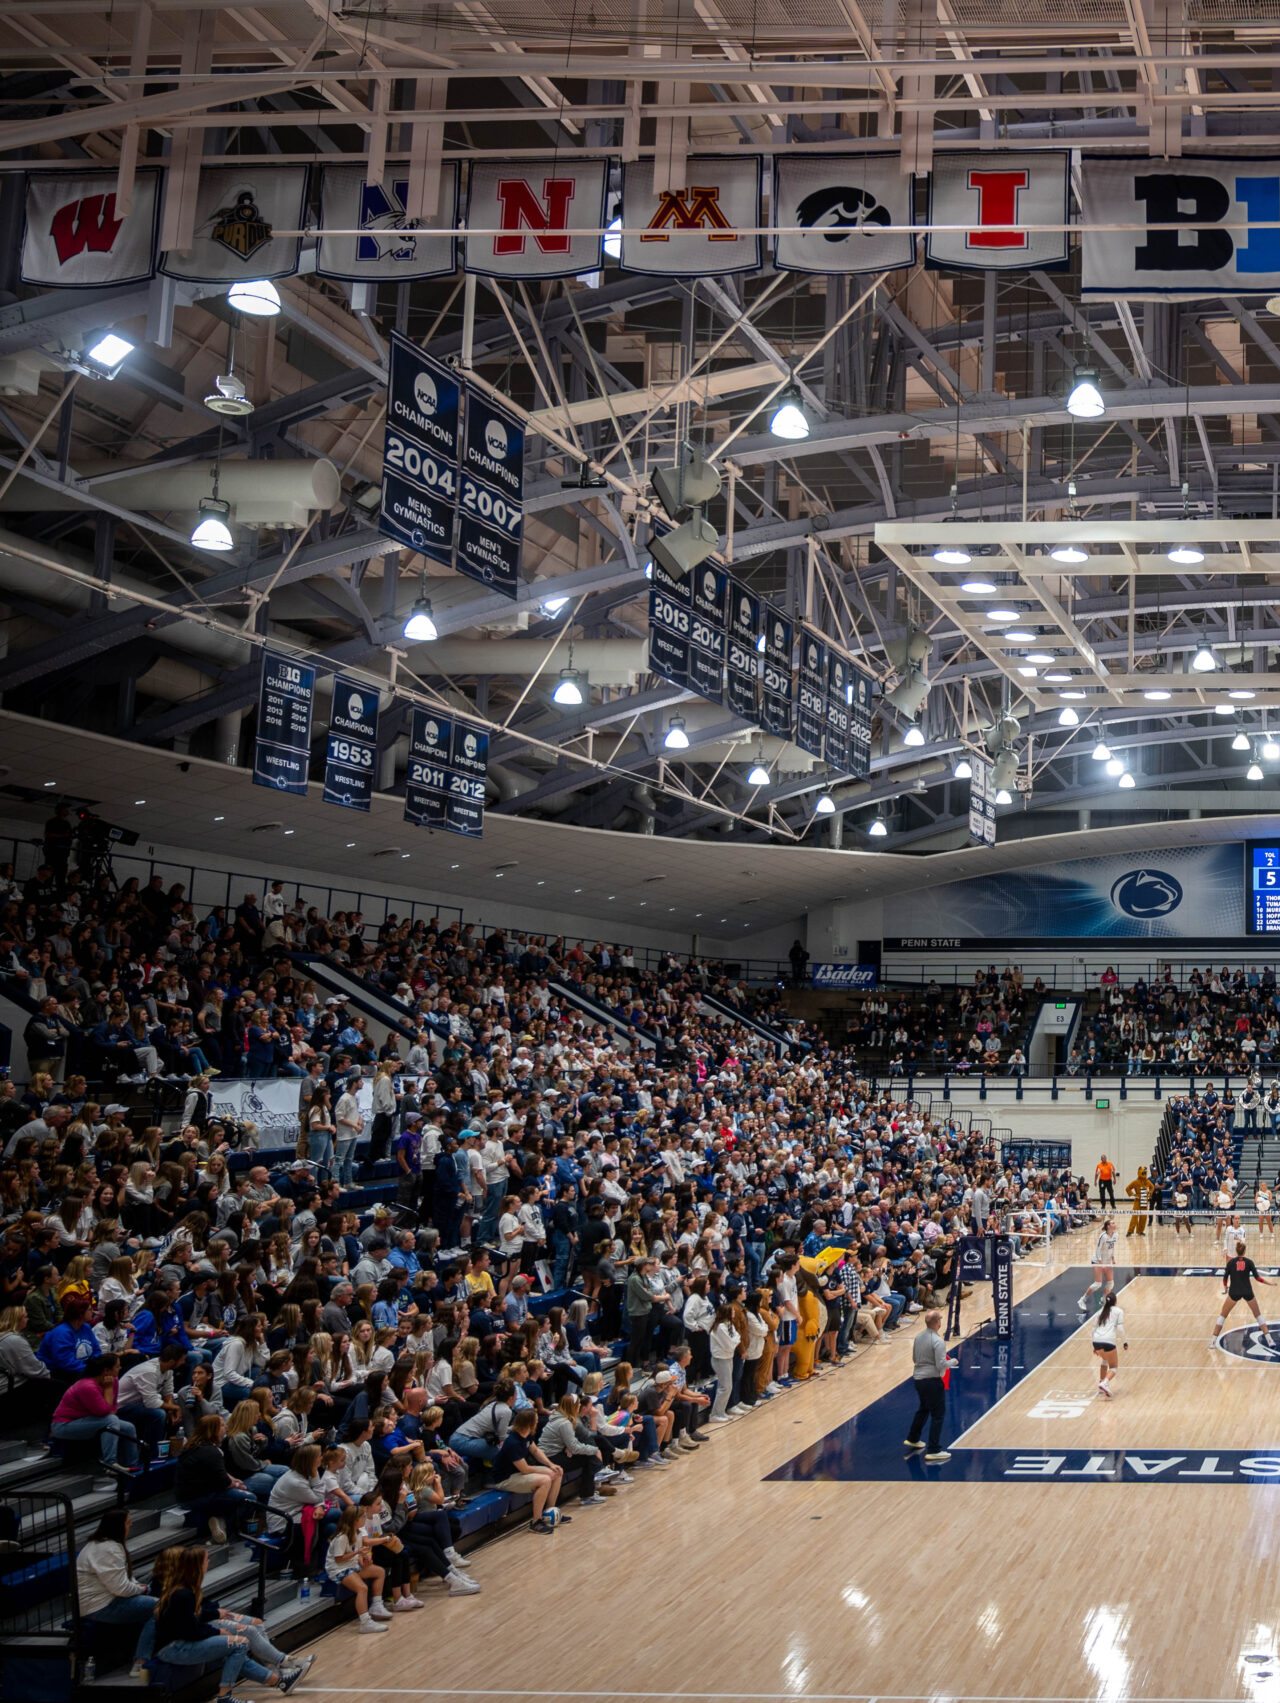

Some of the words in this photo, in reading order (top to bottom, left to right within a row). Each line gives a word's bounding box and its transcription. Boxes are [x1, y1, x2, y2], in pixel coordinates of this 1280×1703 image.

[494, 178, 576, 256] N
[641, 187, 737, 242] M
[966, 169, 1029, 249] I
[50, 193, 122, 266] W
[211, 220, 273, 262] PURDUE
[417, 386, 437, 409] NCAA
[394, 401, 453, 447] CHAMPIONS
[386, 437, 455, 496] 2004
[468, 447, 519, 489] CHAMPIONS
[463, 481, 521, 532] 2007
[393, 503, 445, 537] GYMNASTICS
[466, 541, 510, 574] GYMNASTICS
[655, 598, 690, 633] 2013
[692, 621, 722, 651] 2014
[730, 646, 757, 677] 2016
[266, 676, 311, 698] CHAMPIONS
[764, 669, 789, 694] 2017
[266, 705, 283, 716] 2013
[291, 712, 307, 723] 2014
[268, 695, 284, 705] 2011
[291, 702, 308, 713] 2012
[801, 691, 822, 715] 2018
[334, 715, 374, 736] CHAMPIONS
[828, 707, 849, 731] 2019
[850, 720, 873, 745] 2022
[266, 755, 300, 771] WRESTLING
[331, 740, 372, 767] 1953
[414, 741, 448, 760] CHAMPIONS
[454, 754, 487, 772] CHAMPIONS
[335, 774, 365, 789] WRESTLING
[412, 764, 445, 788] 2011
[449, 776, 486, 799] 2012
[1267, 858, 1273, 866] 2
[1266, 871, 1276, 886] 5
[901, 939, 928, 947] PENN
[930, 939, 961, 947] STATE
[998, 1265, 1008, 1299] STATE
[999, 1302, 1008, 1334] PENN
